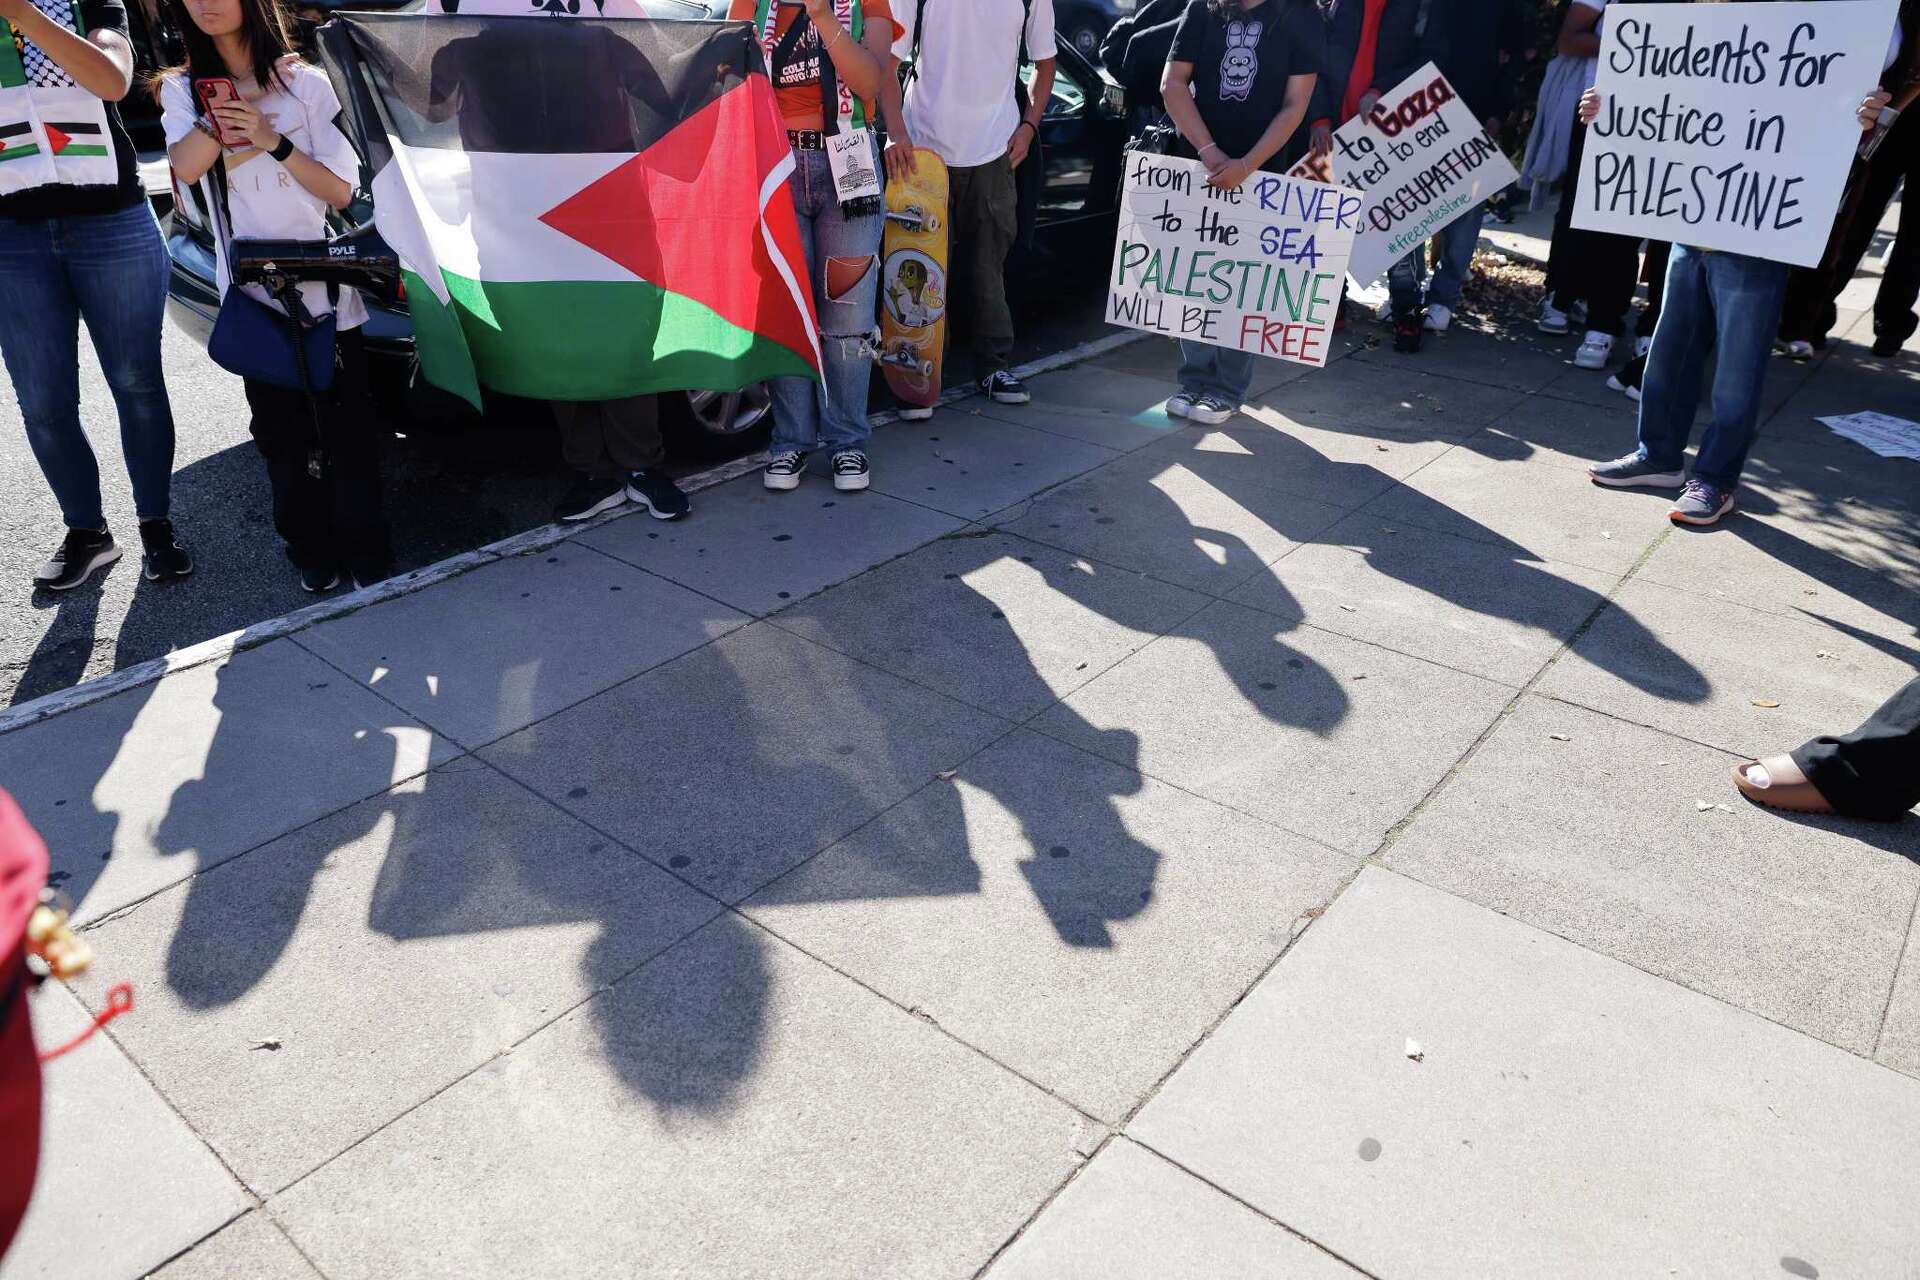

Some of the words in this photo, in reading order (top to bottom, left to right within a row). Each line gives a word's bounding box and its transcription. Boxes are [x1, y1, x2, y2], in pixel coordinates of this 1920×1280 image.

[1610, 18, 1770, 85] Students
[1779, 22, 1846, 88] for
[1334, 133, 1375, 162] to
[1369, 76, 1457, 138] Gaza
[1387, 142, 1414, 162] to
[1416, 111, 1450, 149] end
[1593, 94, 1725, 147] Justice
[1745, 109, 1784, 153] in
[228, 171, 290, 192] AIR
[1132, 156, 1190, 196] from
[1254, 176, 1361, 230] RIVER
[1369, 129, 1498, 232] OCCUPATION
[1594, 152, 1804, 231] PALESTINE
[328, 245, 356, 256] PYLE
[1152, 200, 1182, 232] to
[1195, 206, 1239, 246] the
[1260, 225, 1323, 268] SEA
[1386, 191, 1472, 254] #freepalestine
[1118, 240, 1335, 325] PALESTINE
[1113, 292, 1170, 332] WILL
[1181, 304, 1222, 340] BE
[1239, 315, 1325, 363] FREE
